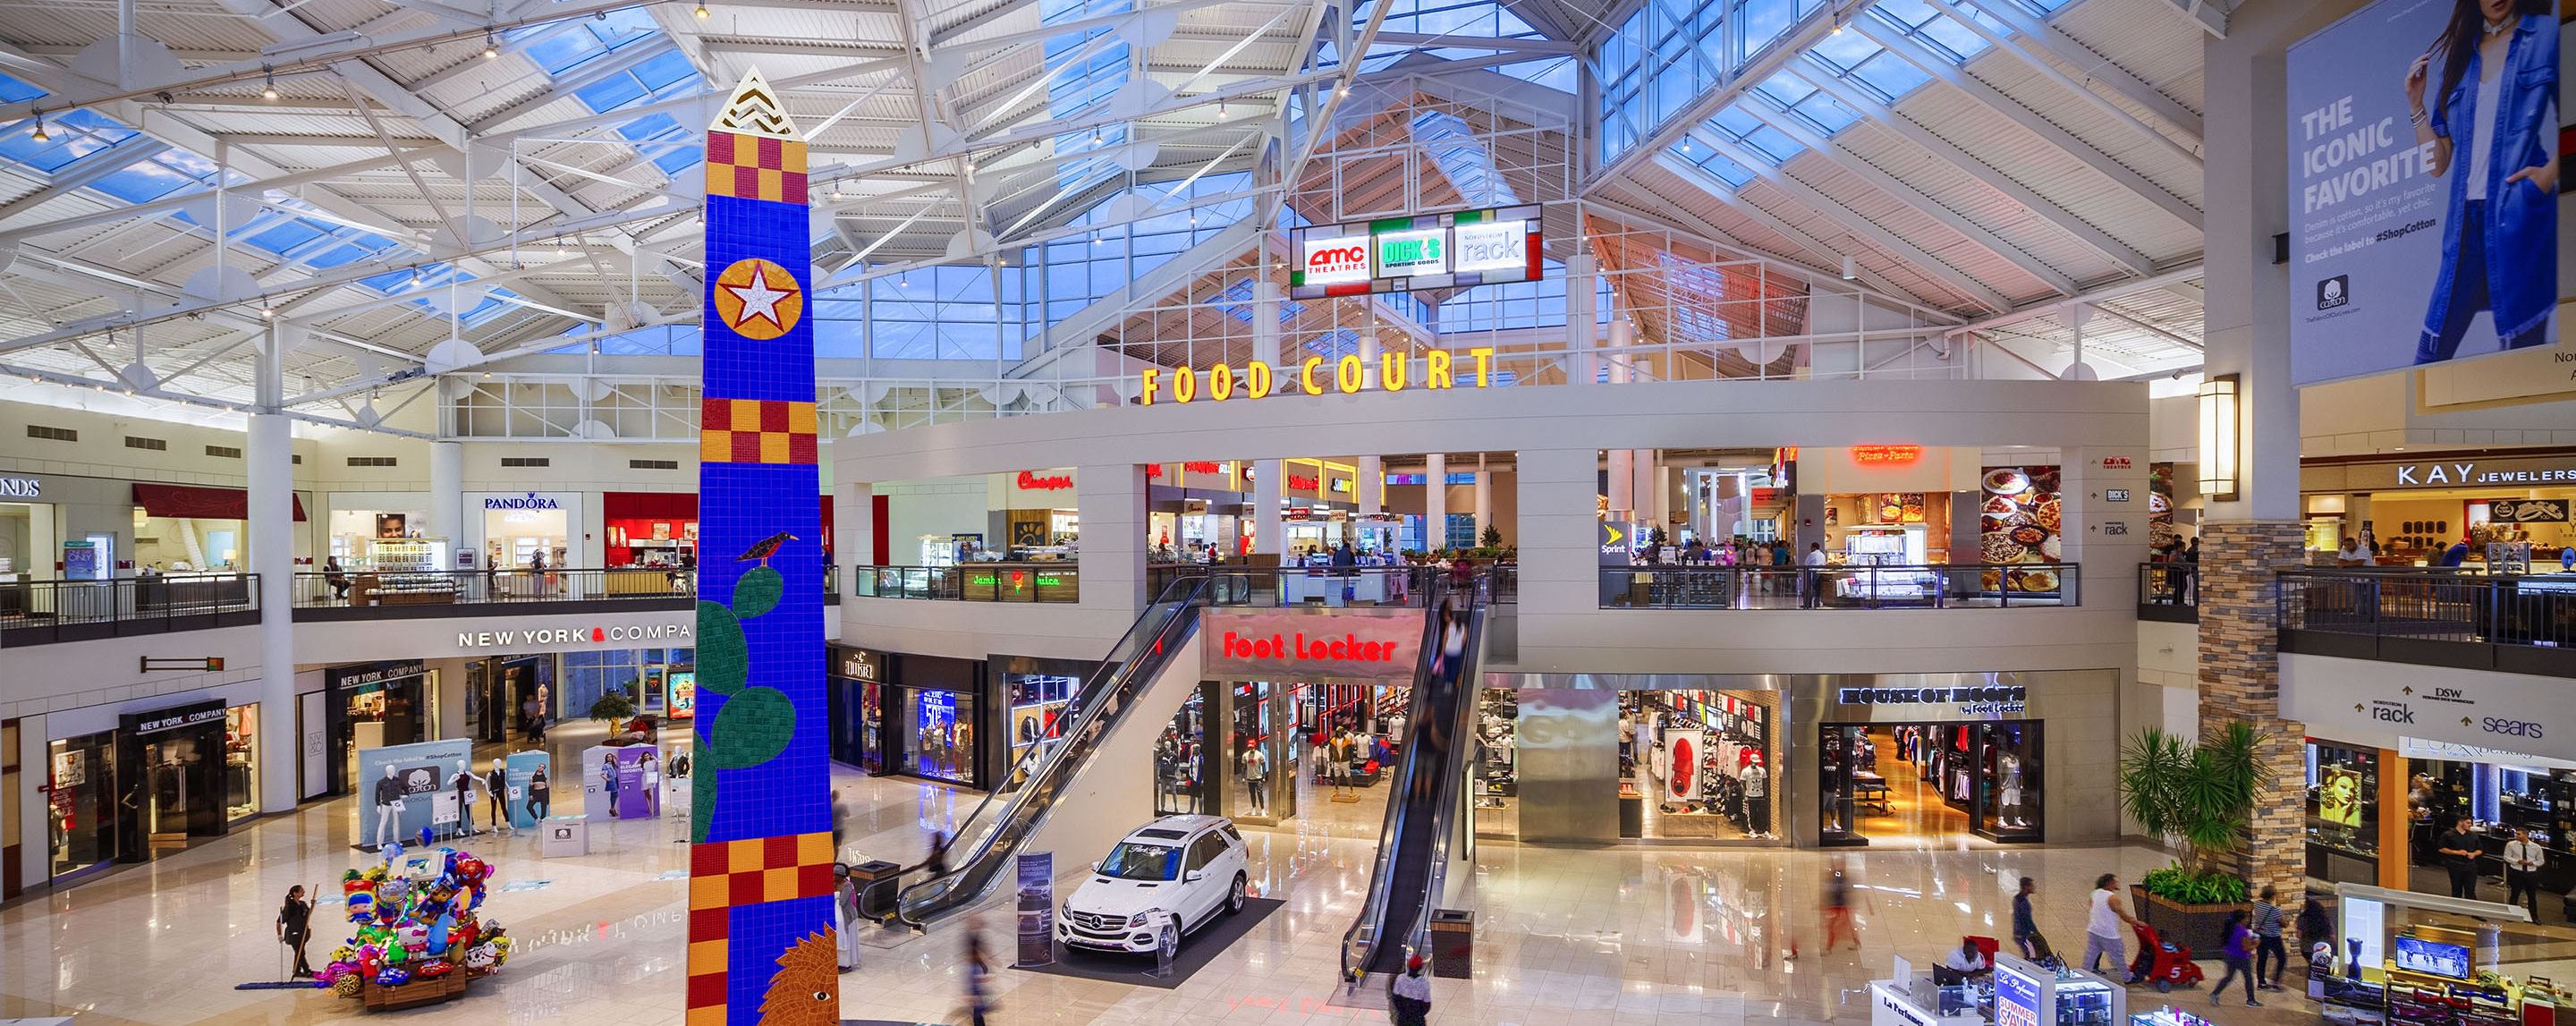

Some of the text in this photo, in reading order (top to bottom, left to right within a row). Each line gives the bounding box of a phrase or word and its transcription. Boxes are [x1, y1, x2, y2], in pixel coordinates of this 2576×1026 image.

[2301, 95, 2353, 140] THE
[2303, 116, 2394, 179] ICONIC
[2304, 140, 2436, 214] FAVORITE
[2304, 219, 2328, 233] Denim
[2364, 205, 2374, 213] so
[2376, 198, 2386, 209] it's
[2388, 193, 2402, 206] my
[2404, 182, 2436, 199] favorite
[2305, 230, 2334, 244] because
[2397, 204, 2411, 216] yet
[1463, 232, 1519, 262] rack
[1464, 233, 1504, 241] NORDSTROM
[2305, 218, 2436, 263] Check the label to #ShopCotton
[1382, 237, 1440, 263] DICK'S
[1308, 263, 1367, 274] THEATRES
[1385, 259, 1439, 268] SPORTING GOODS
[1142, 348, 1494, 406] FOOD COURT
[1858, 452, 1883, 461] Pizza
[1888, 451, 1914, 460] Pasta
[2398, 463, 2576, 485] KAY JEWELERS
[485, 497, 559, 509] PANDORA
[2105, 521, 2129, 535] rack
[1601, 544, 1626, 555] Sprint
[458, 632, 514, 648] NEW
[522, 628, 586, 645] YORK
[610, 624, 691, 640] COMPA
[1224, 631, 1397, 662] Foot Locker
[341, 664, 423, 687] NEW YORK COMPANY
[1840, 686, 2026, 704] HOUSE OF HOOPS
[2436, 687, 2462, 698] DSW
[140, 708, 225, 731] NEW YORK COMPANY
[1961, 703, 2025, 715] by Foot Locker
[2372, 704, 2414, 724] rack
[2482, 716, 2543, 739] sears
[426, 752, 462, 760] #ShopCotton
[1998, 972, 2009, 985] La
[2169, 967, 2182, 979] 5
[1884, 996, 1893, 1009] La
[2000, 997, 2036, 1023] SUMMER
